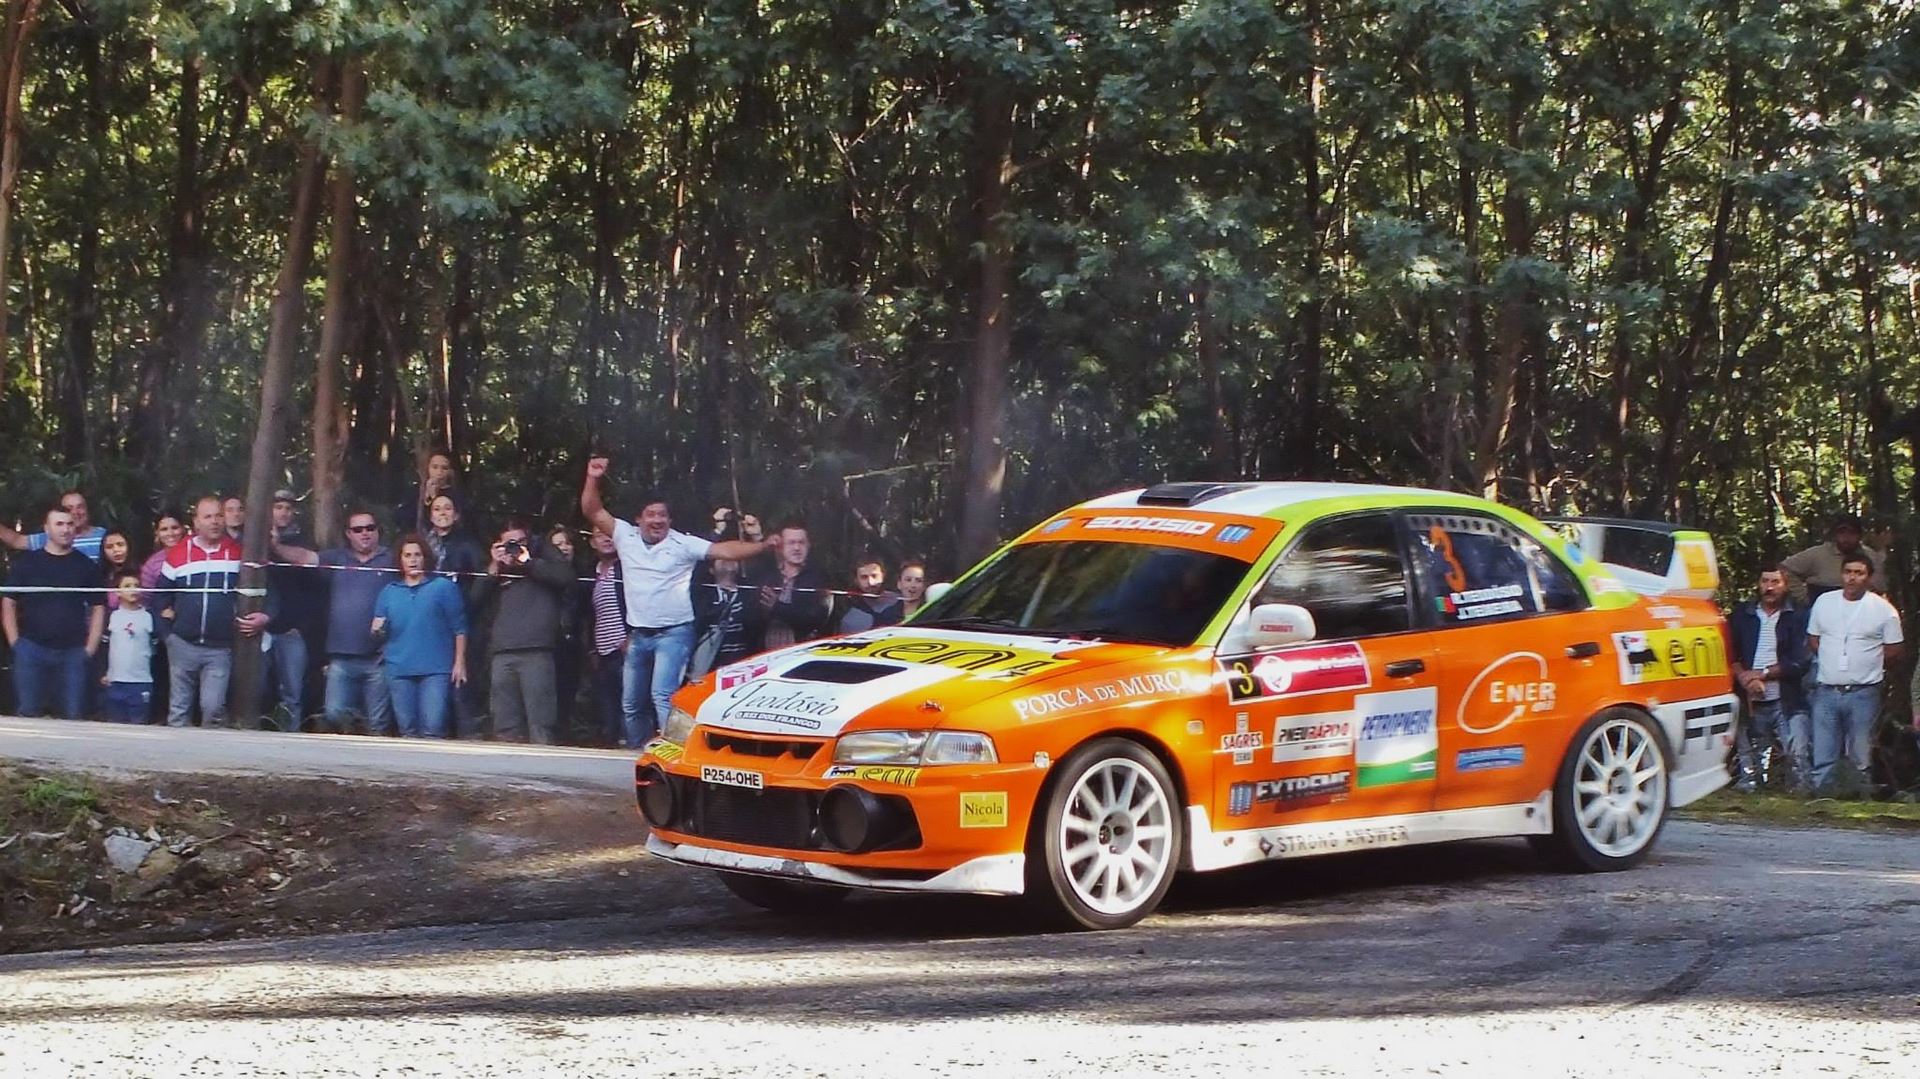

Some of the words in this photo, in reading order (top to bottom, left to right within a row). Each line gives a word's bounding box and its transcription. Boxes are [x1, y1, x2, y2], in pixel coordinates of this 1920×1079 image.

[1429, 526, 1467, 593] 3
[1233, 661, 1255, 695] 3
[721, 678, 840, 721] Teodósio
[1014, 687, 1094, 721] PORCA
[1094, 684, 1120, 701] DE
[1490, 681, 1557, 703] ENER
[776, 714, 821, 730] FRANGOS
[1223, 733, 1260, 750] SAGRES
[704, 768, 760, 787] P254-OHE
[964, 802, 1004, 817] Nicola
[1277, 834, 1339, 853] STRONG
[1345, 825, 1410, 847] ANSWER
